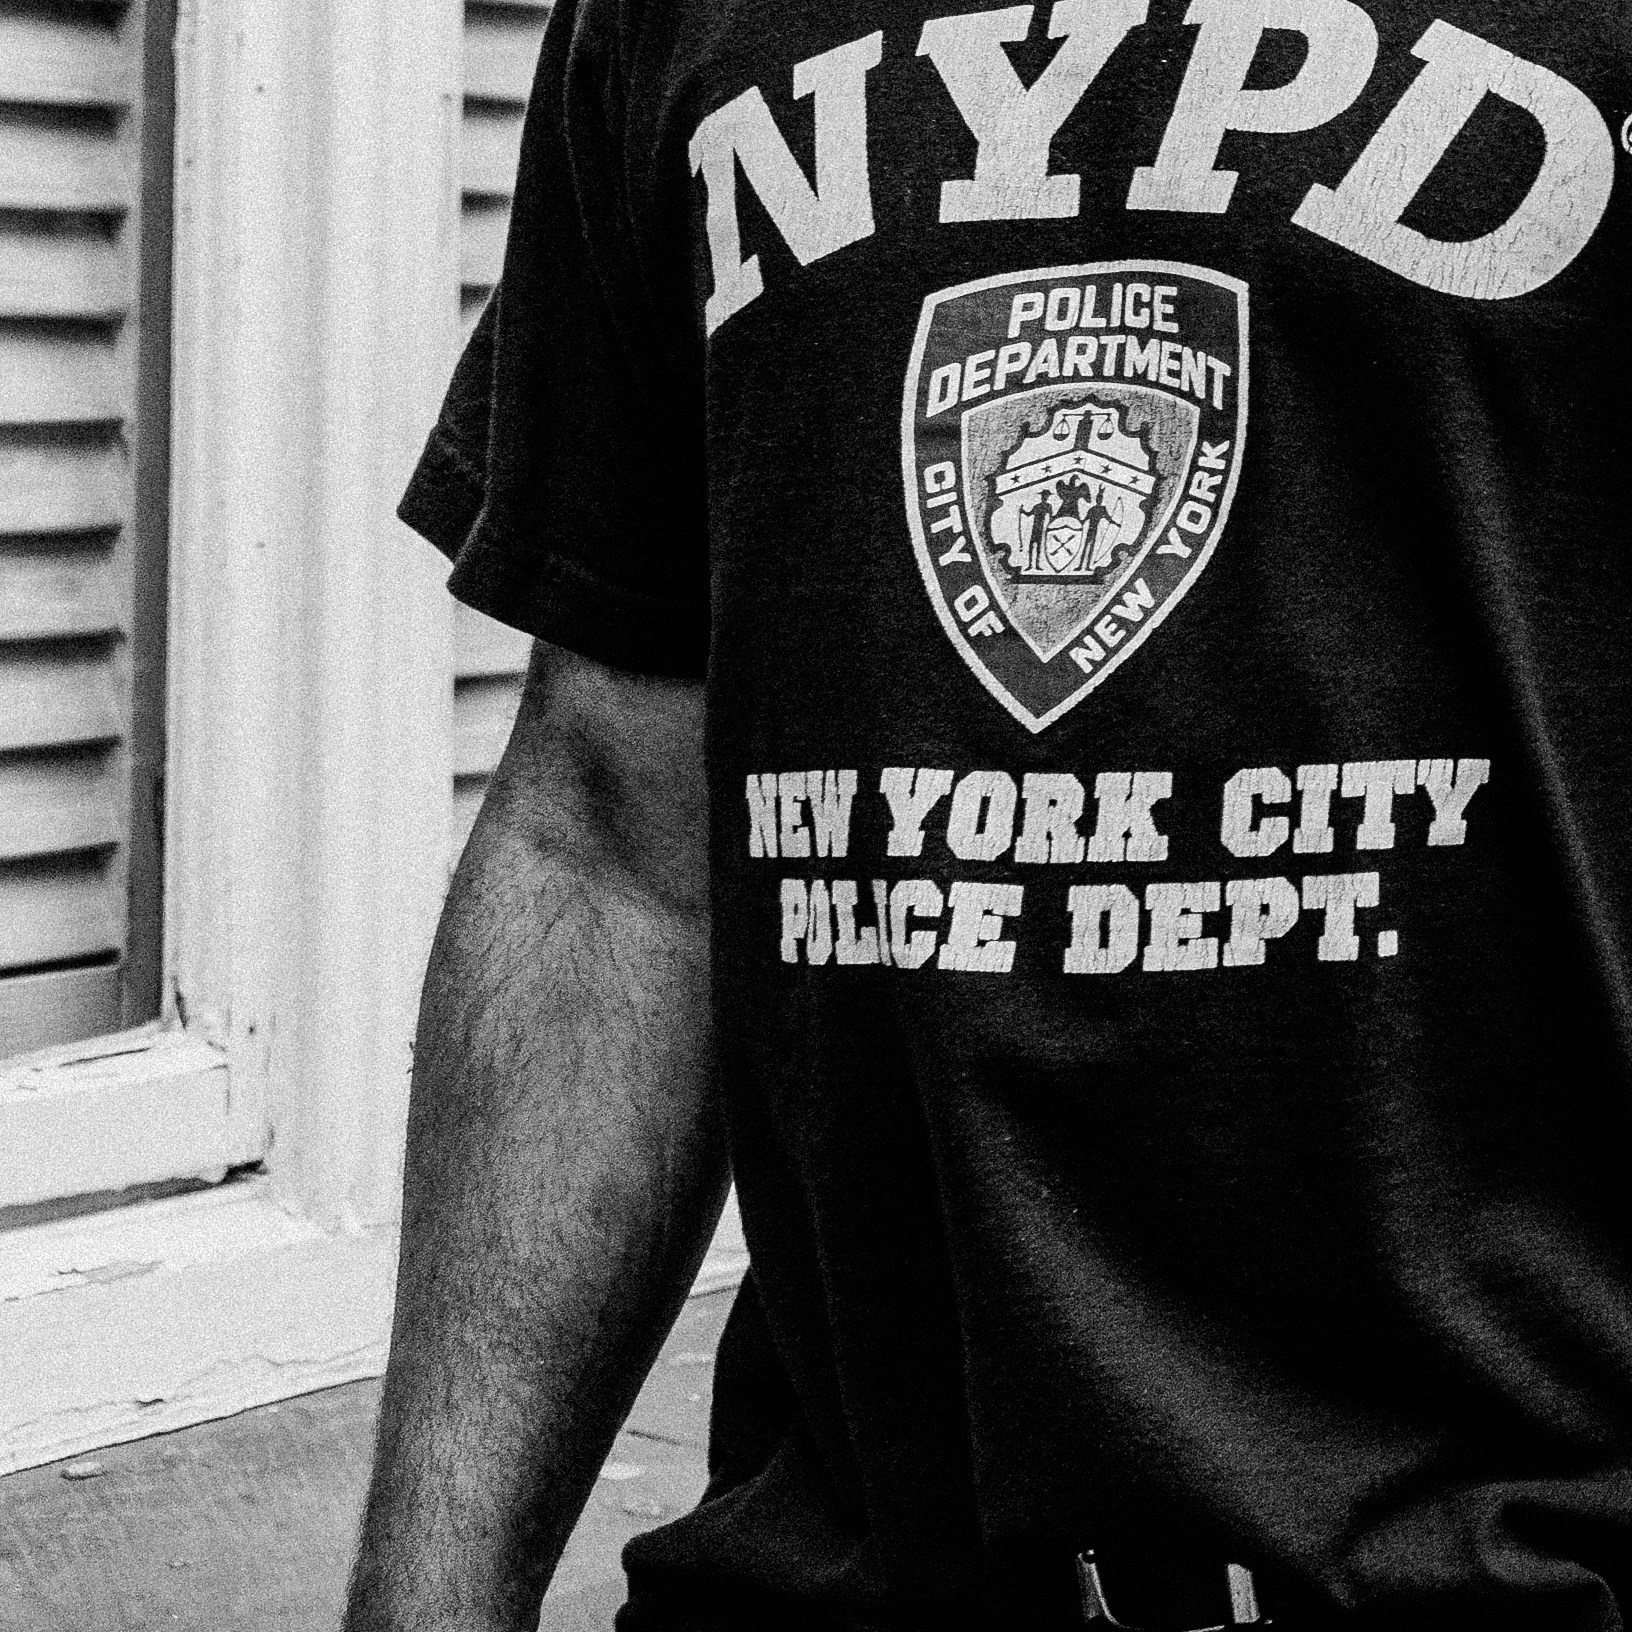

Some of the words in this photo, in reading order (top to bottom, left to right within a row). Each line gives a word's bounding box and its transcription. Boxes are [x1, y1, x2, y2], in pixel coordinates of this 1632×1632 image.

[1007, 282, 1179, 338] POLICE
[926, 334, 1231, 419] DEPARTMENT
[922, 460, 972, 567] CITY
[954, 584, 1005, 638] OF
[1069, 578, 1156, 674] NEW
[1157, 439, 1231, 559] YORK
[745, 769, 858, 859] NEW
[880, 766, 1173, 864] YORK
[1220, 758, 1491, 858] CITY
[780, 878, 1024, 973] POLICE
[1063, 871, 1399, 975] DEPT.
